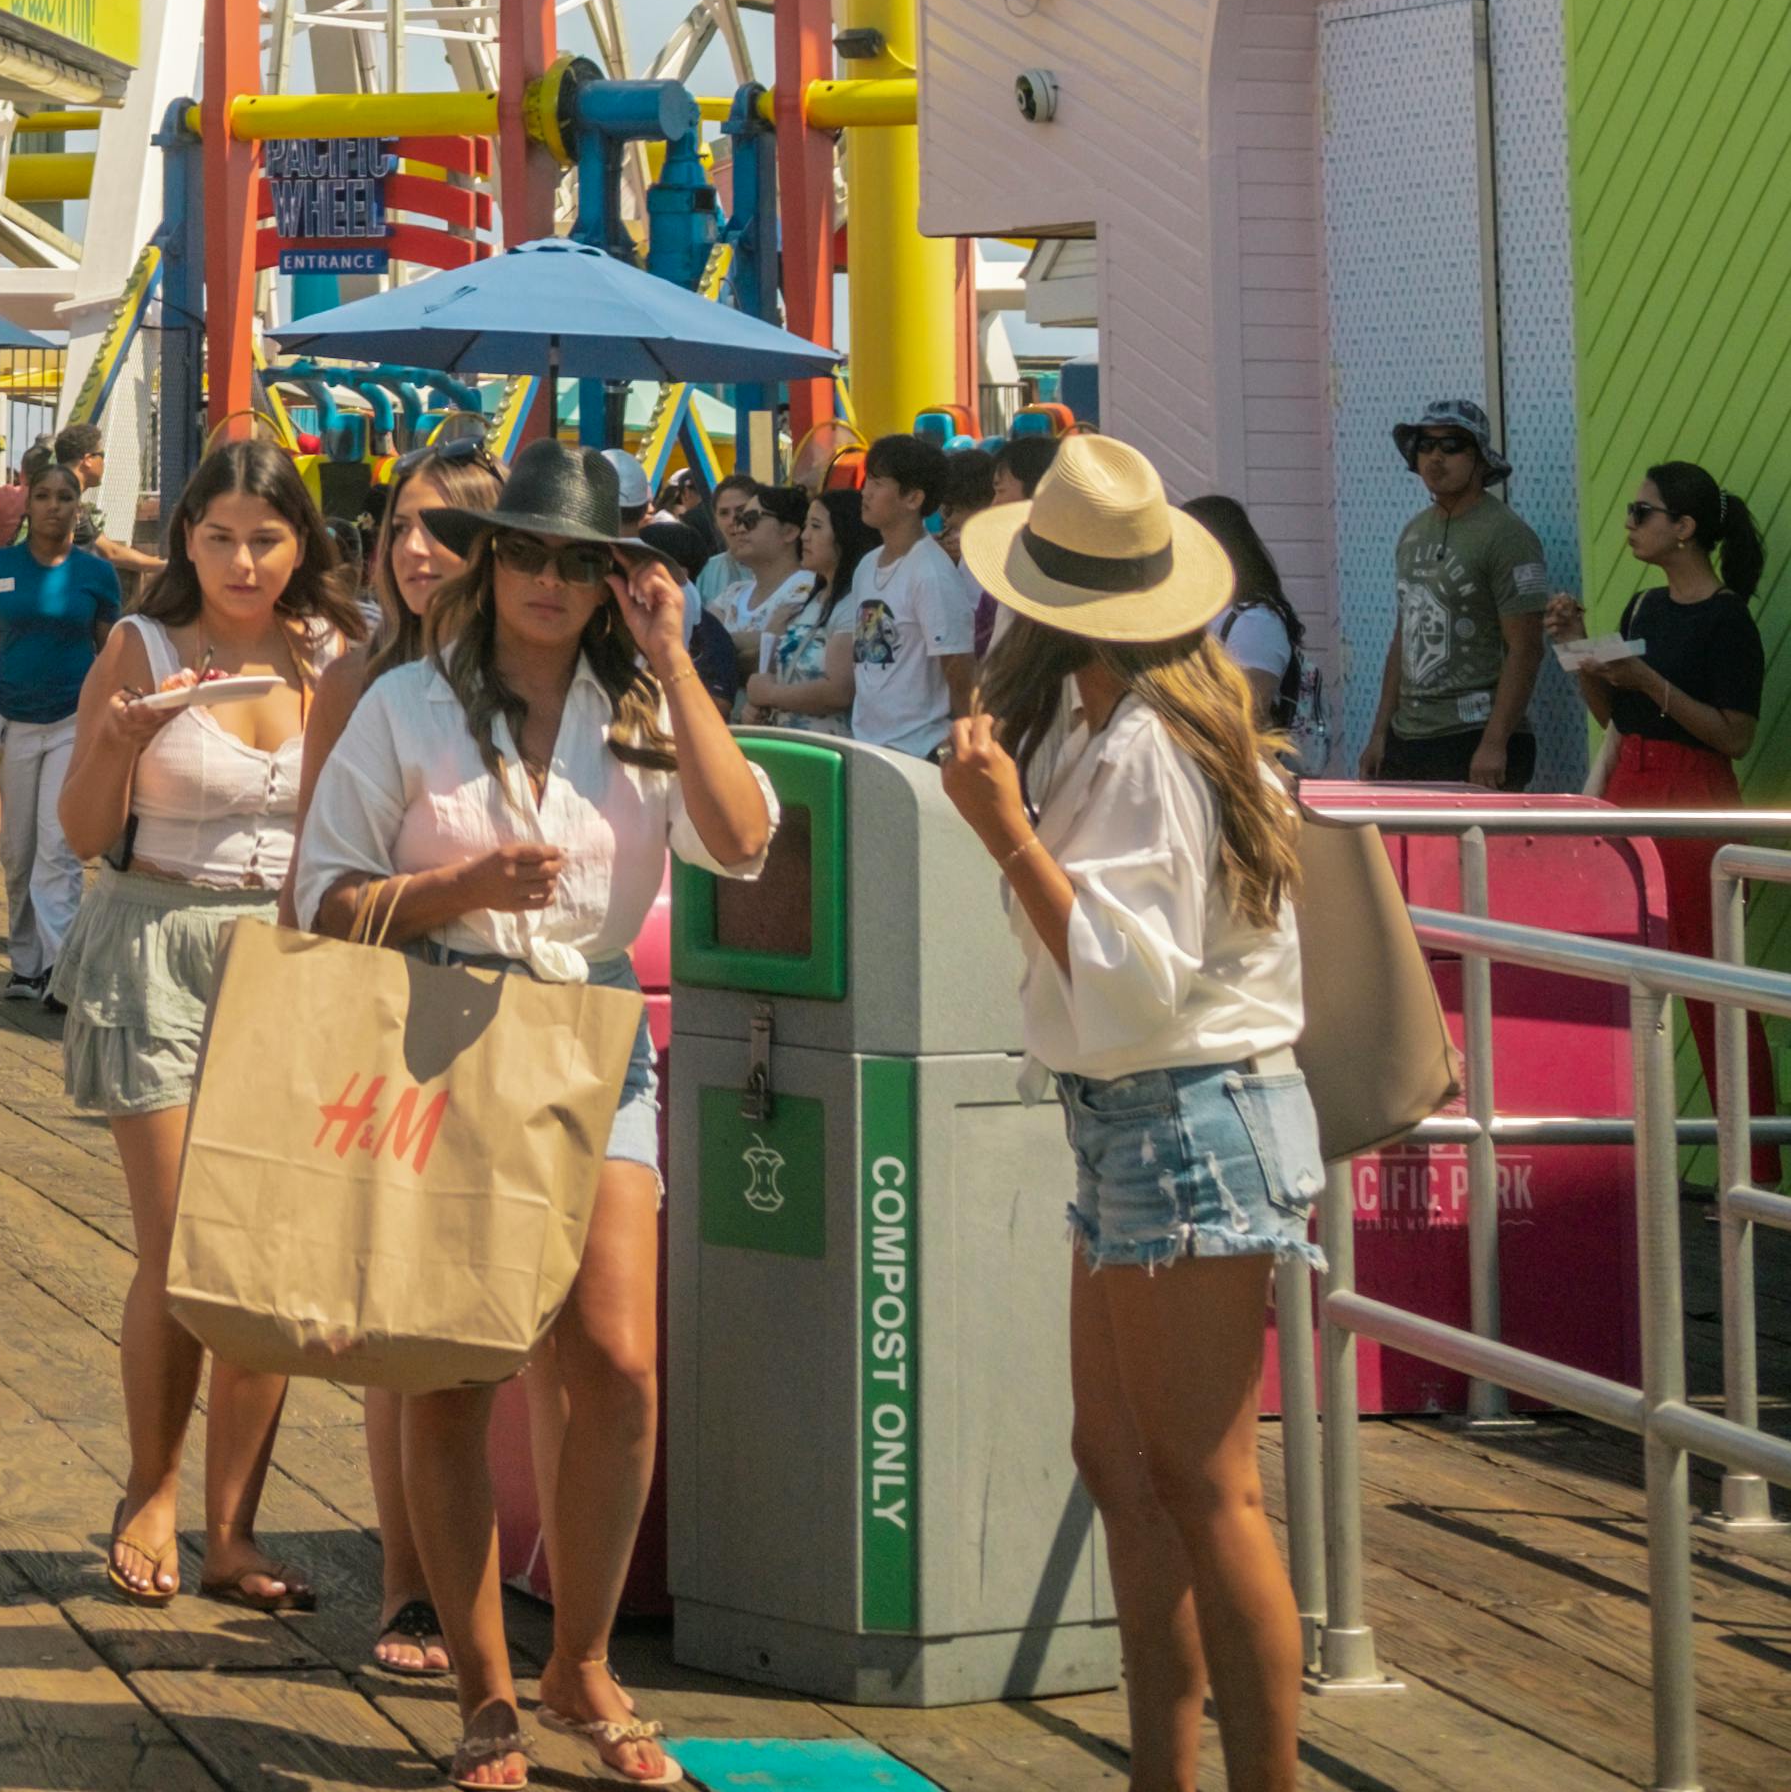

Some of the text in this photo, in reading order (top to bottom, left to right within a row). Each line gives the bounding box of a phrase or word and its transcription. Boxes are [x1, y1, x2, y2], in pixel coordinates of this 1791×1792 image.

[265, 136, 398, 177] PACIFIC
[270, 179, 386, 237] WHEEL
[283, 254, 375, 270] ENTRANCE
[313, 1072, 450, 1176] H&M
[1351, 1165, 1533, 1215] CIFIC PRK
[871, 1155, 907, 1531] COMPOST ONLY
